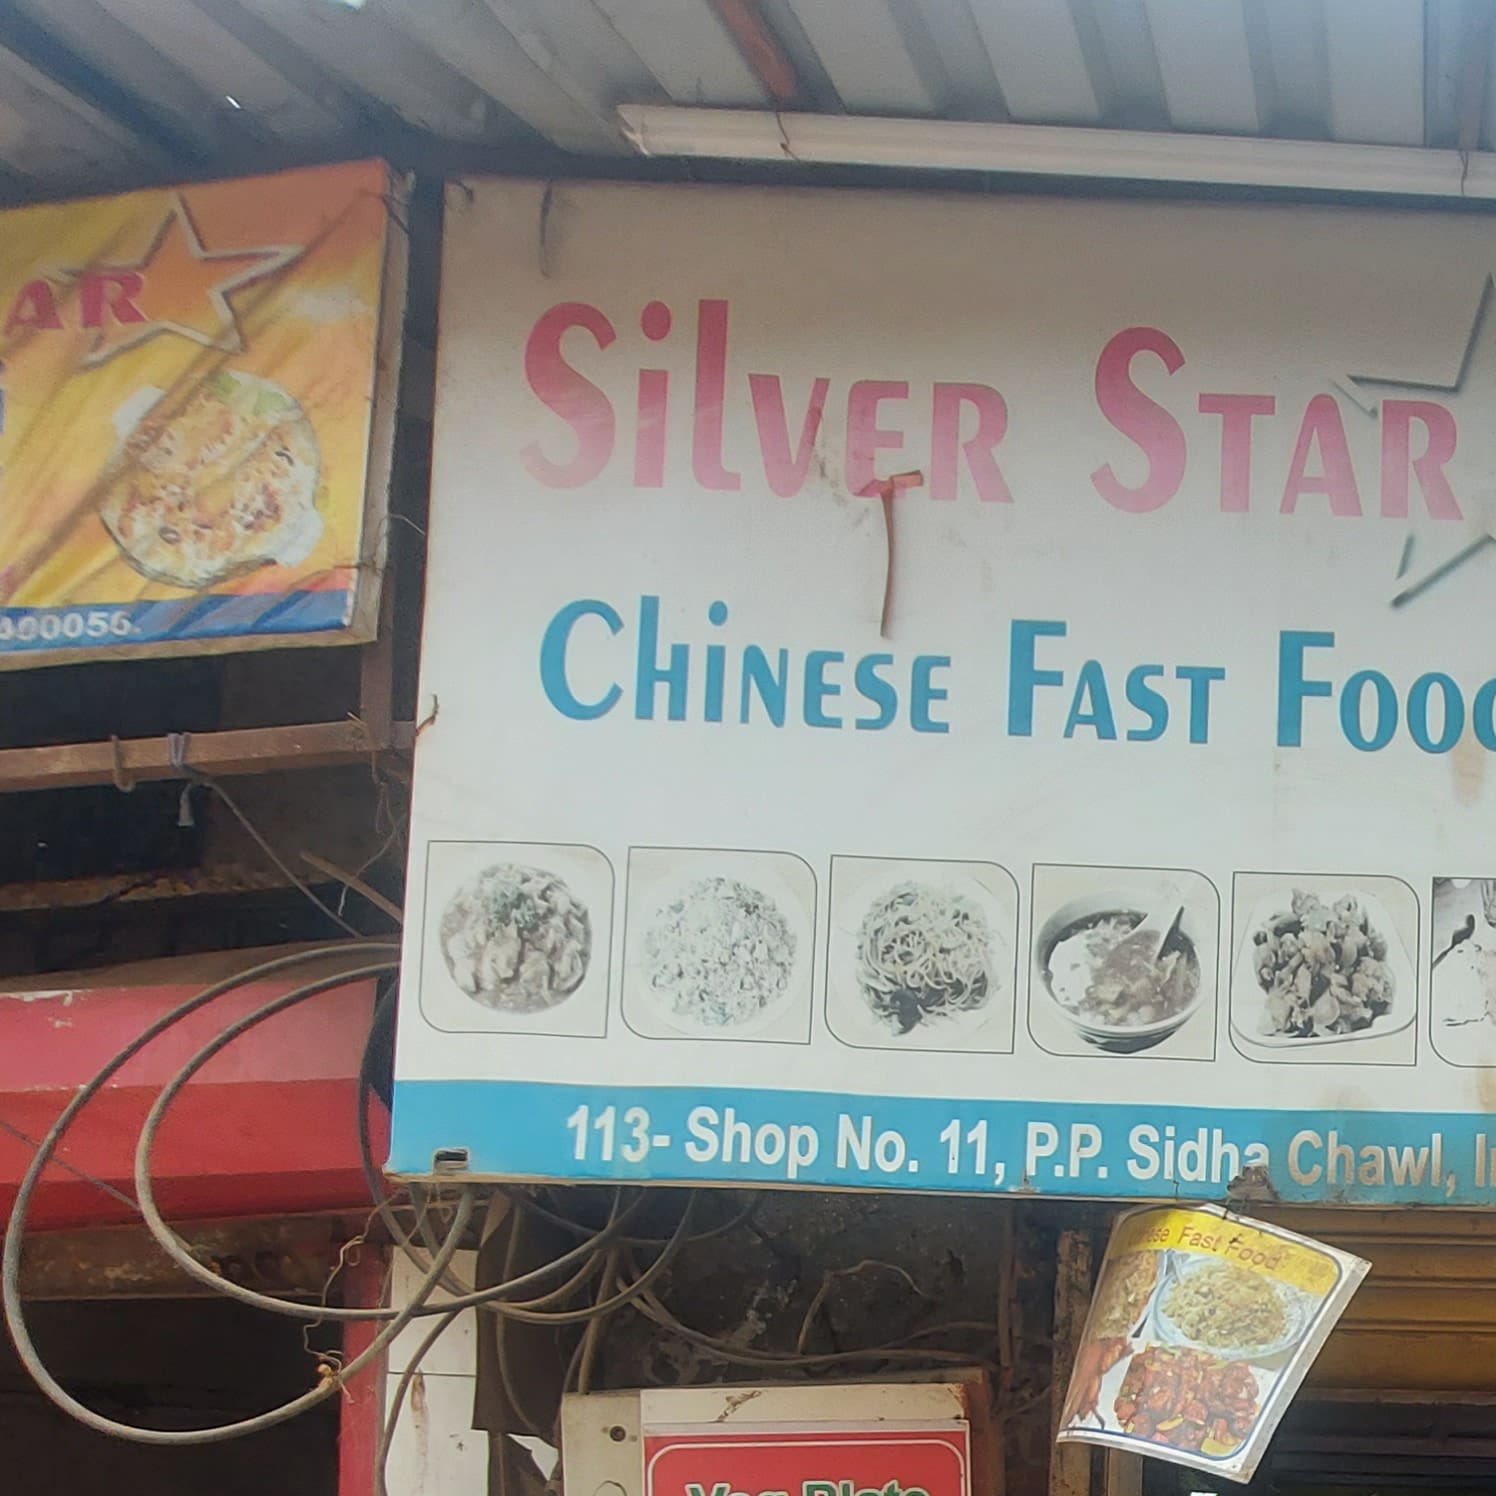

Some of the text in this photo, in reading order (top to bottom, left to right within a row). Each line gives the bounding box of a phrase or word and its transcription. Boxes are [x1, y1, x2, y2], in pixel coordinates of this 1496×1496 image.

[566, 1104, 670, 1163] 113-
[685, 1113, 818, 1178] Shop
[837, 1115, 919, 1173] No.
[939, 1119, 1006, 1186] 11,
[1025, 1121, 1107, 1178] P.P.
[1127, 1124, 1270, 1183] Sidha
[1288, 1129, 1455, 1197] Chawl,
[1177, 1227, 1222, 1252] Fast
[1224, 1234, 1281, 1271] Food
